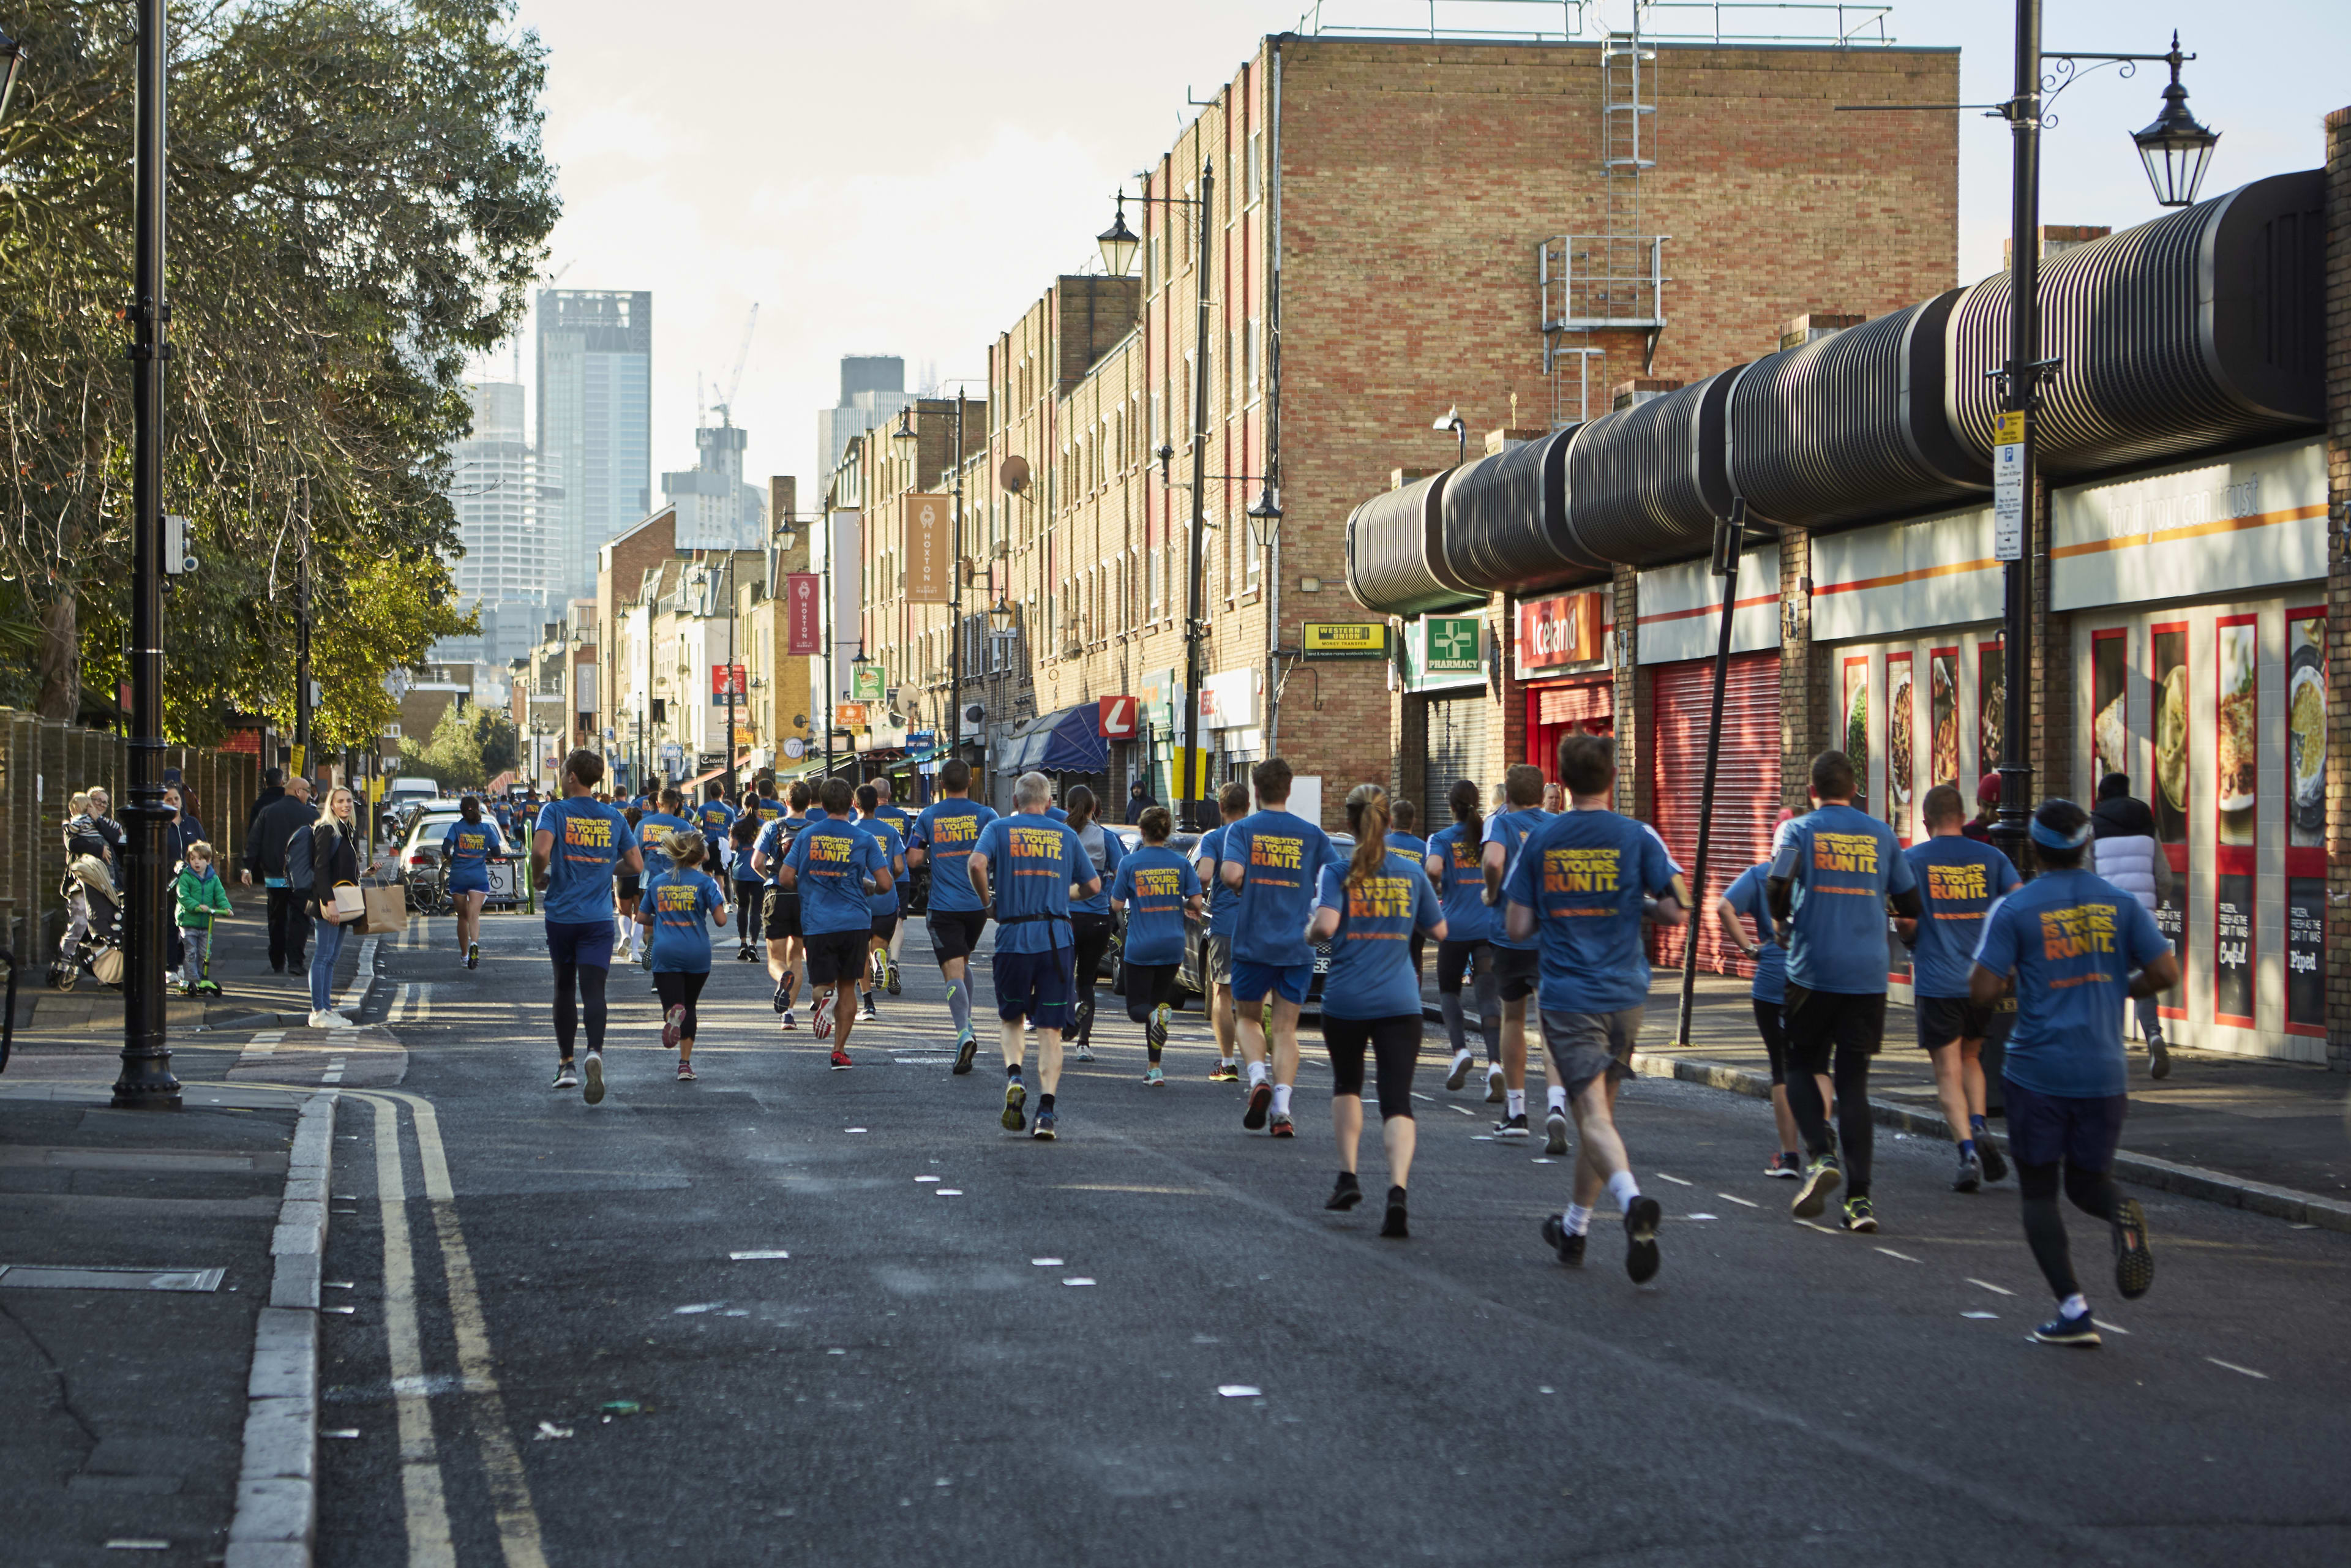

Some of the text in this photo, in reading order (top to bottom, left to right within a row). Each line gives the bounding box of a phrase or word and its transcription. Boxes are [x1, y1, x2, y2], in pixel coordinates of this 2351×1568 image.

[2006, 448, 2012, 462] P
[2107, 472, 2258, 544] food you can trust
[1532, 608, 1576, 656] Iceland
[1428, 660, 1478, 669] PHARMACY
[661, 747, 681, 758] Nails
[566, 817, 611, 827] SHOREDITCH
[934, 815, 977, 824] SHOREDITCH
[566, 823, 612, 835] IS YOURS.
[934, 821, 978, 833] IS YOURS.
[1010, 828, 1063, 838] SHOREDITCH
[566, 832, 612, 847] RUN IT.
[811, 836, 853, 844] SHOREDITCH
[934, 828, 978, 843] RUN IT.
[1010, 835, 1063, 847] IS YOURS.
[1253, 835, 1303, 846] SHOREDITCH
[1813, 833, 1878, 846] SHOREDITCH
[821, 842, 852, 852] YOURS.
[1010, 844, 1062, 860] RUN IT.
[1252, 842, 1302, 856] IS YOURS.
[1813, 841, 1879, 858] IS YOURS.
[809, 849, 850, 862] RUN IT.
[1251, 852, 1302, 869] RUN IT.
[1544, 849, 1621, 860] SHOREDITCH
[1543, 859, 1620, 873] IS YOURS.
[1814, 853, 1878, 874] RUN IT.
[1927, 864, 1986, 874] SHOREDITCH
[1135, 875, 1180, 885] IS YOURS.
[1544, 873, 1619, 893] RUN IT.
[1928, 872, 1987, 885] IS YOURS.
[1136, 883, 1180, 898] RUN IT.
[1349, 888, 1412, 901] IS YOURS.
[1929, 883, 1989, 899] RUN IT.
[658, 900, 695, 912] RUN IT.
[1349, 900, 1412, 918] RUN IT.
[2039, 904, 2118, 924] SHOREDITCH
[2041, 915, 2117, 939] IS YOURS.
[2219, 925, 2248, 938] DAY IT WAS
[2290, 929, 2321, 943] DAY IT WAS
[2044, 931, 2115, 961] RUN IT.
[2290, 950, 2317, 973] Piped
